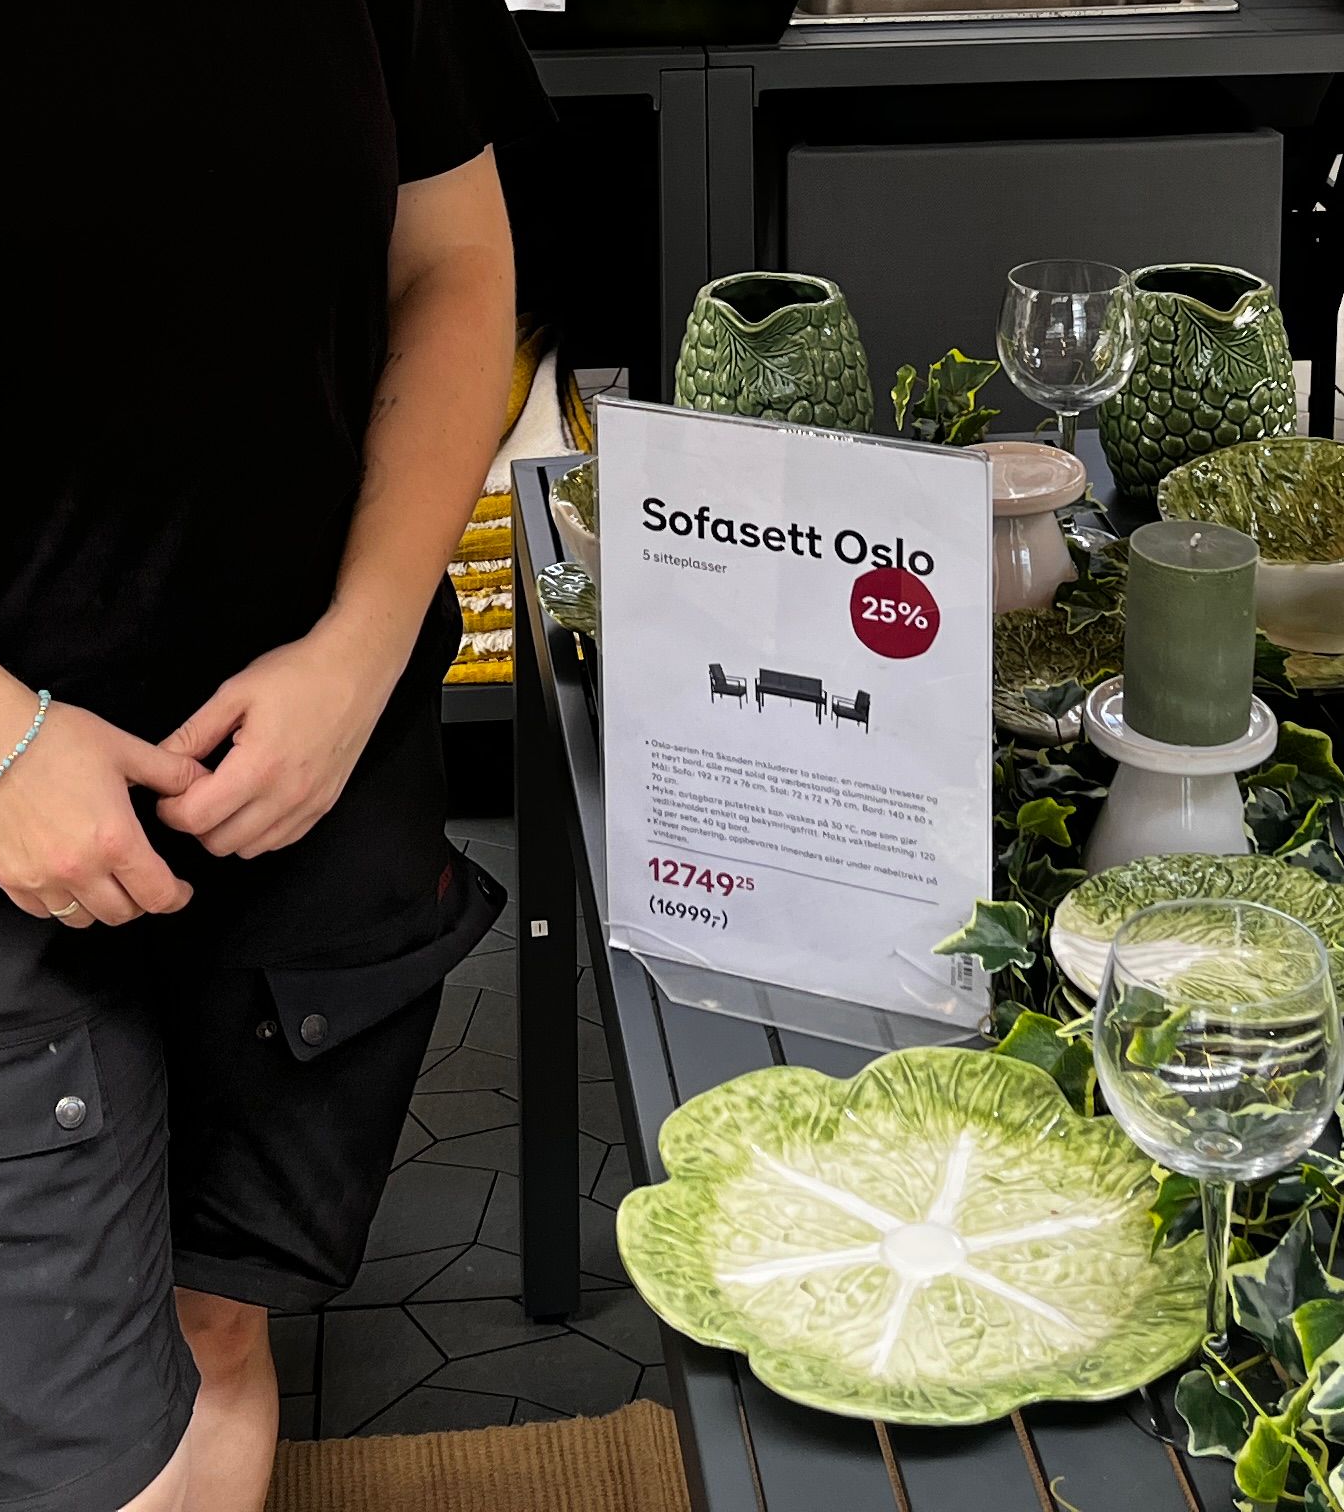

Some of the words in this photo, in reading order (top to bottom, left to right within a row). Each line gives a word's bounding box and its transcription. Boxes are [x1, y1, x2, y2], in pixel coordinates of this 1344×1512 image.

[642, 497, 823, 559] Sofasett
[834, 529, 935, 576] Oslo
[642, 549, 651, 561] 5
[653, 551, 728, 574] sitteplasser
[861, 595, 929, 630] 25%
[649, 894, 728, 930] (16999,-)
